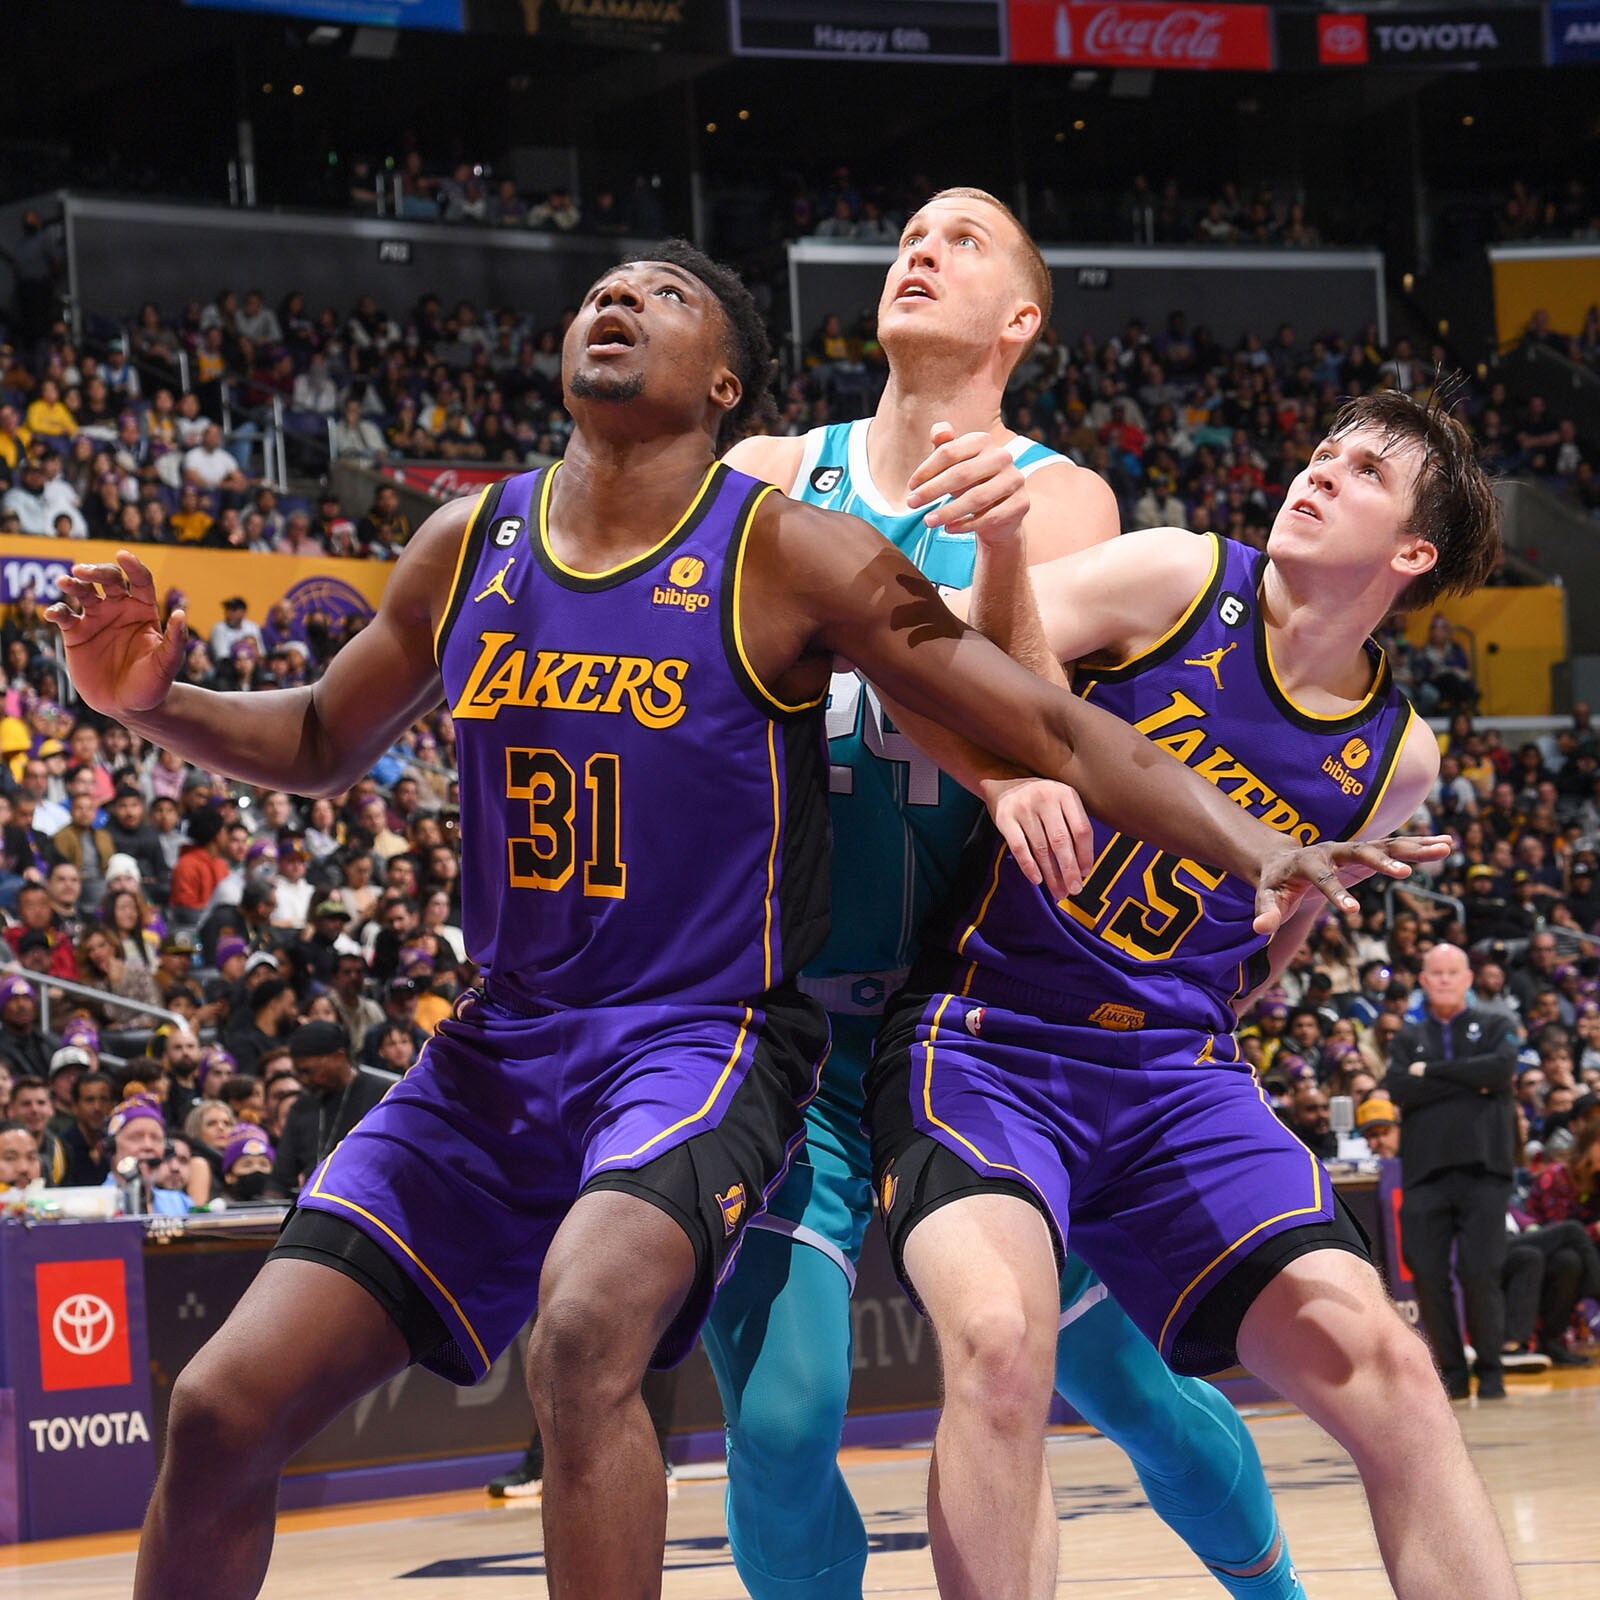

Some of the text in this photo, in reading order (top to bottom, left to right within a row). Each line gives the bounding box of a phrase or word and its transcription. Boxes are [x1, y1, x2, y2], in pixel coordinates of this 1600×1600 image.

[813, 24, 888, 54] Happy
[1376, 23, 1497, 50] TOYOTA
[814, 470, 841, 491] 6
[495, 520, 521, 546] 6
[652, 586, 711, 613] bibigo
[1219, 595, 1244, 626] 6
[451, 630, 690, 730] LAKERS
[1320, 754, 1364, 797] bibigo
[504, 746, 628, 900] 31
[1056, 830, 1229, 962] 15
[1090, 1005, 1146, 1031] LAKERS
[28, 1410, 150, 1453] TOYOTA
